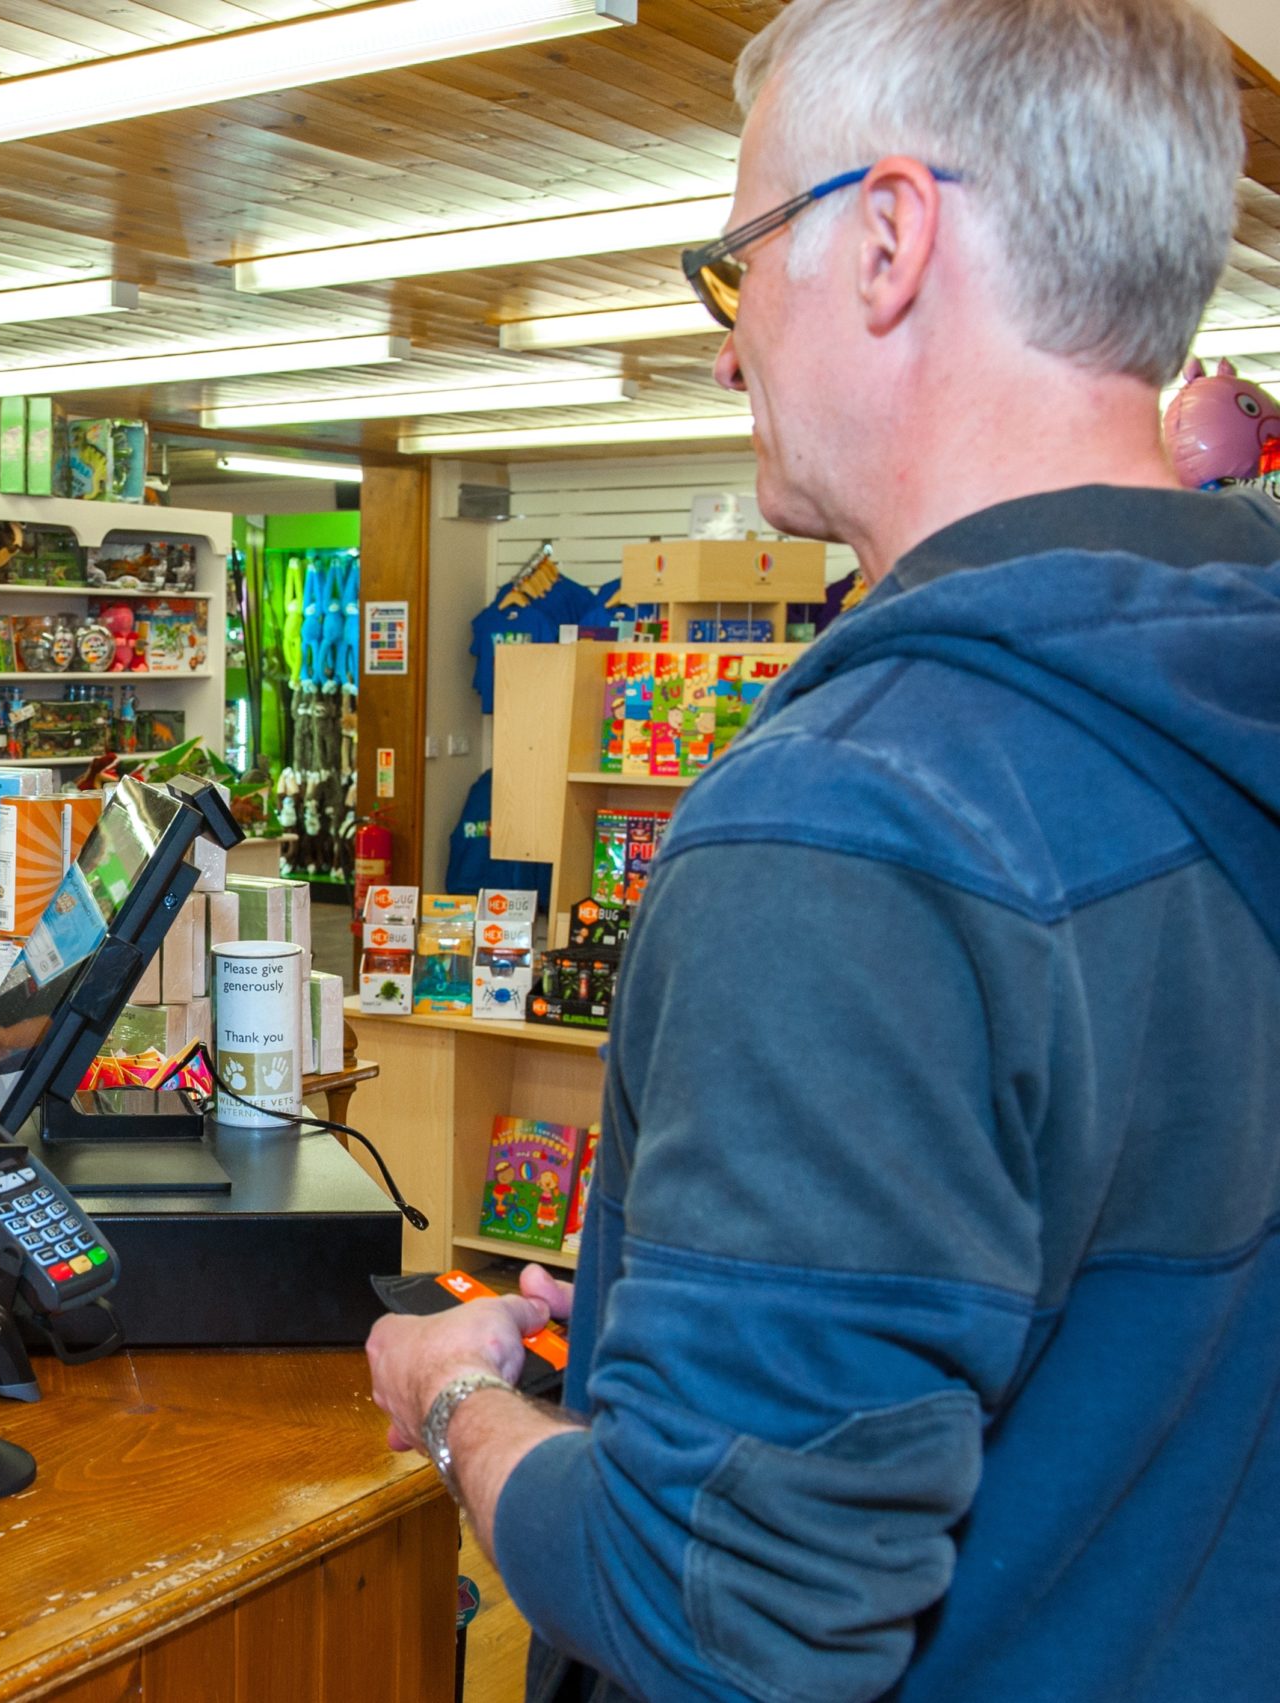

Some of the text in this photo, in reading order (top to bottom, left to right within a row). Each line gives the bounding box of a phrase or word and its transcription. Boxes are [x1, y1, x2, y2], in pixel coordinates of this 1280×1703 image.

[488, 899, 529, 911] HEXBUG
[579, 908, 619, 920] HEXBUG
[371, 931, 407, 942] HEXBUG
[223, 961, 284, 977] Please give
[223, 980, 284, 993] generously
[225, 1030, 284, 1045] Thank you
[271, 1096, 294, 1106] VETS
